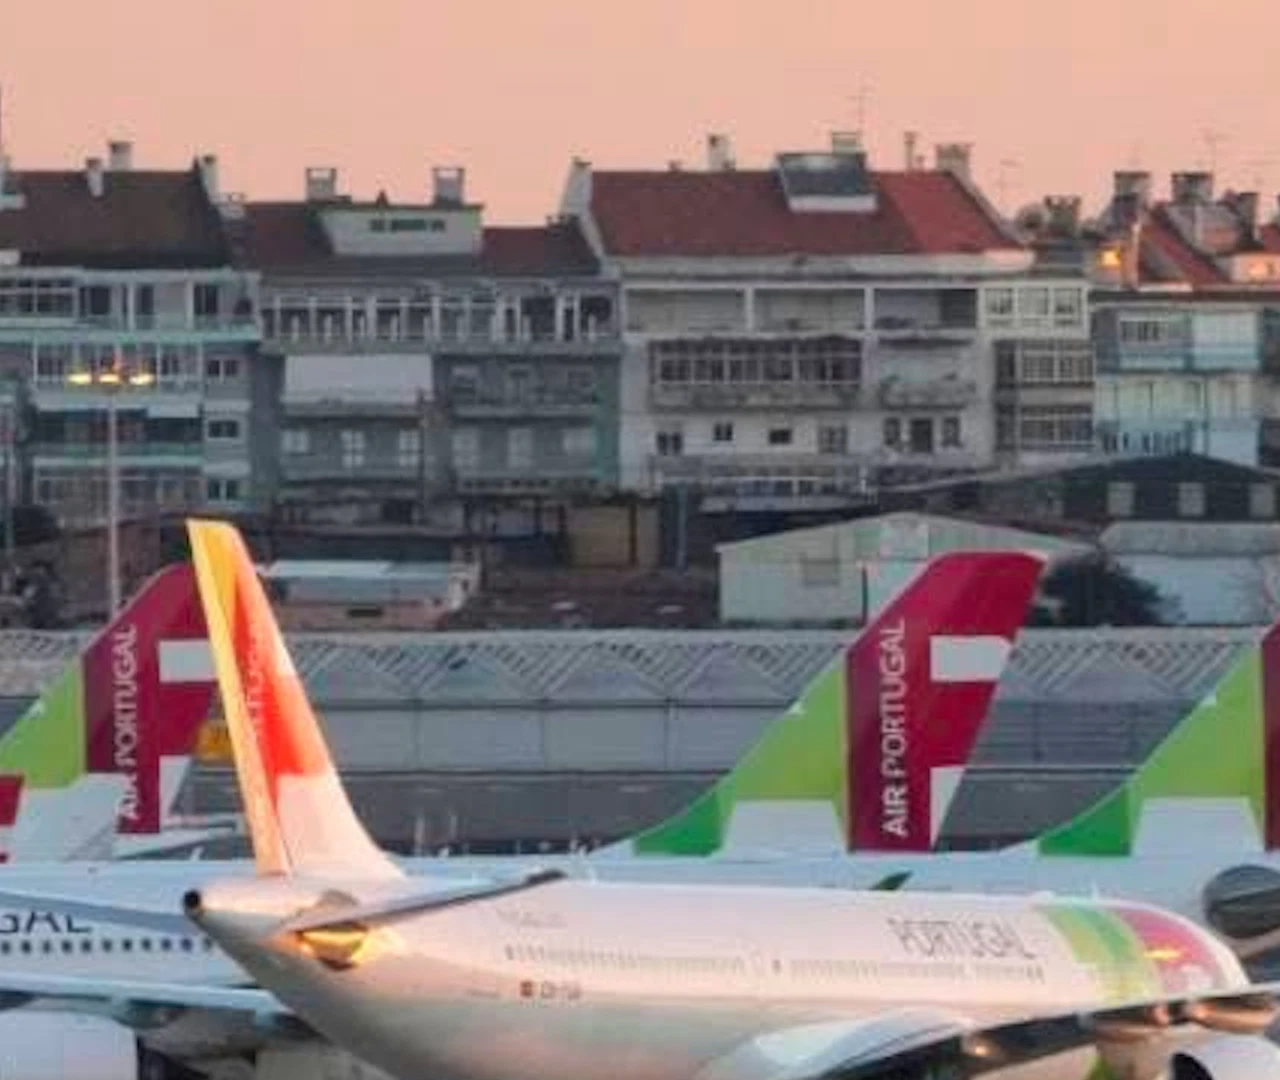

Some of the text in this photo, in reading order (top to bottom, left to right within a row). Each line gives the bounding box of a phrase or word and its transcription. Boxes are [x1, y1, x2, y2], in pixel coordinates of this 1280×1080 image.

[112, 623, 138, 767] PORTUGAL
[879, 617, 908, 838] AIR PORTUGAL
[886, 915, 1037, 960] PORTUGAL
